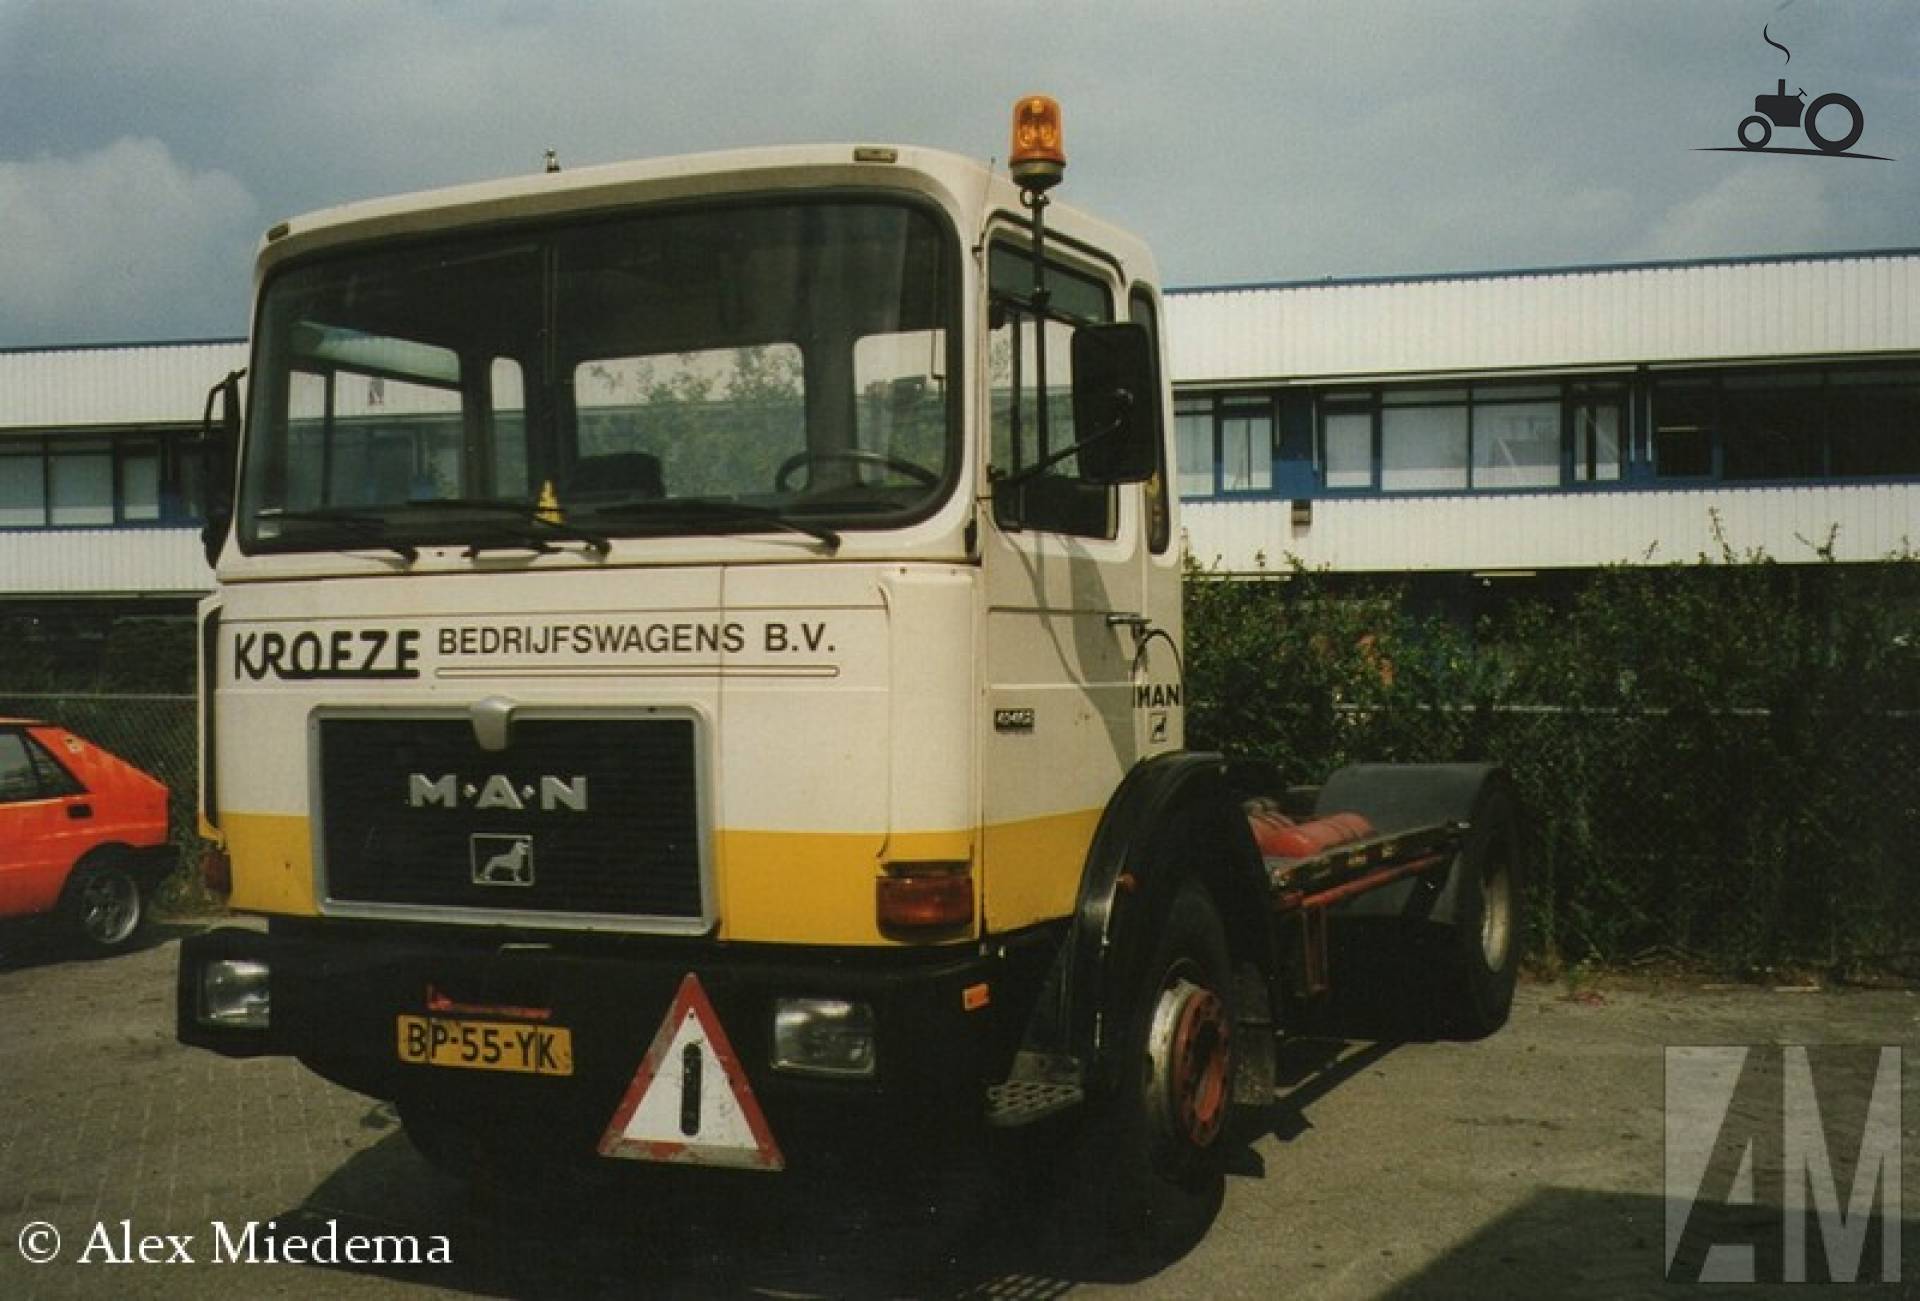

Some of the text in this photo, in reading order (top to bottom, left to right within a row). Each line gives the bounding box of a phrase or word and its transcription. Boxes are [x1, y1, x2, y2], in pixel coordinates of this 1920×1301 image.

[234, 623, 836, 680] KROEZE BEDRIJFSWAGENS B.V.
[1136, 684, 1179, 708] MAN
[407, 1022, 557, 1069] BP-55-YK
